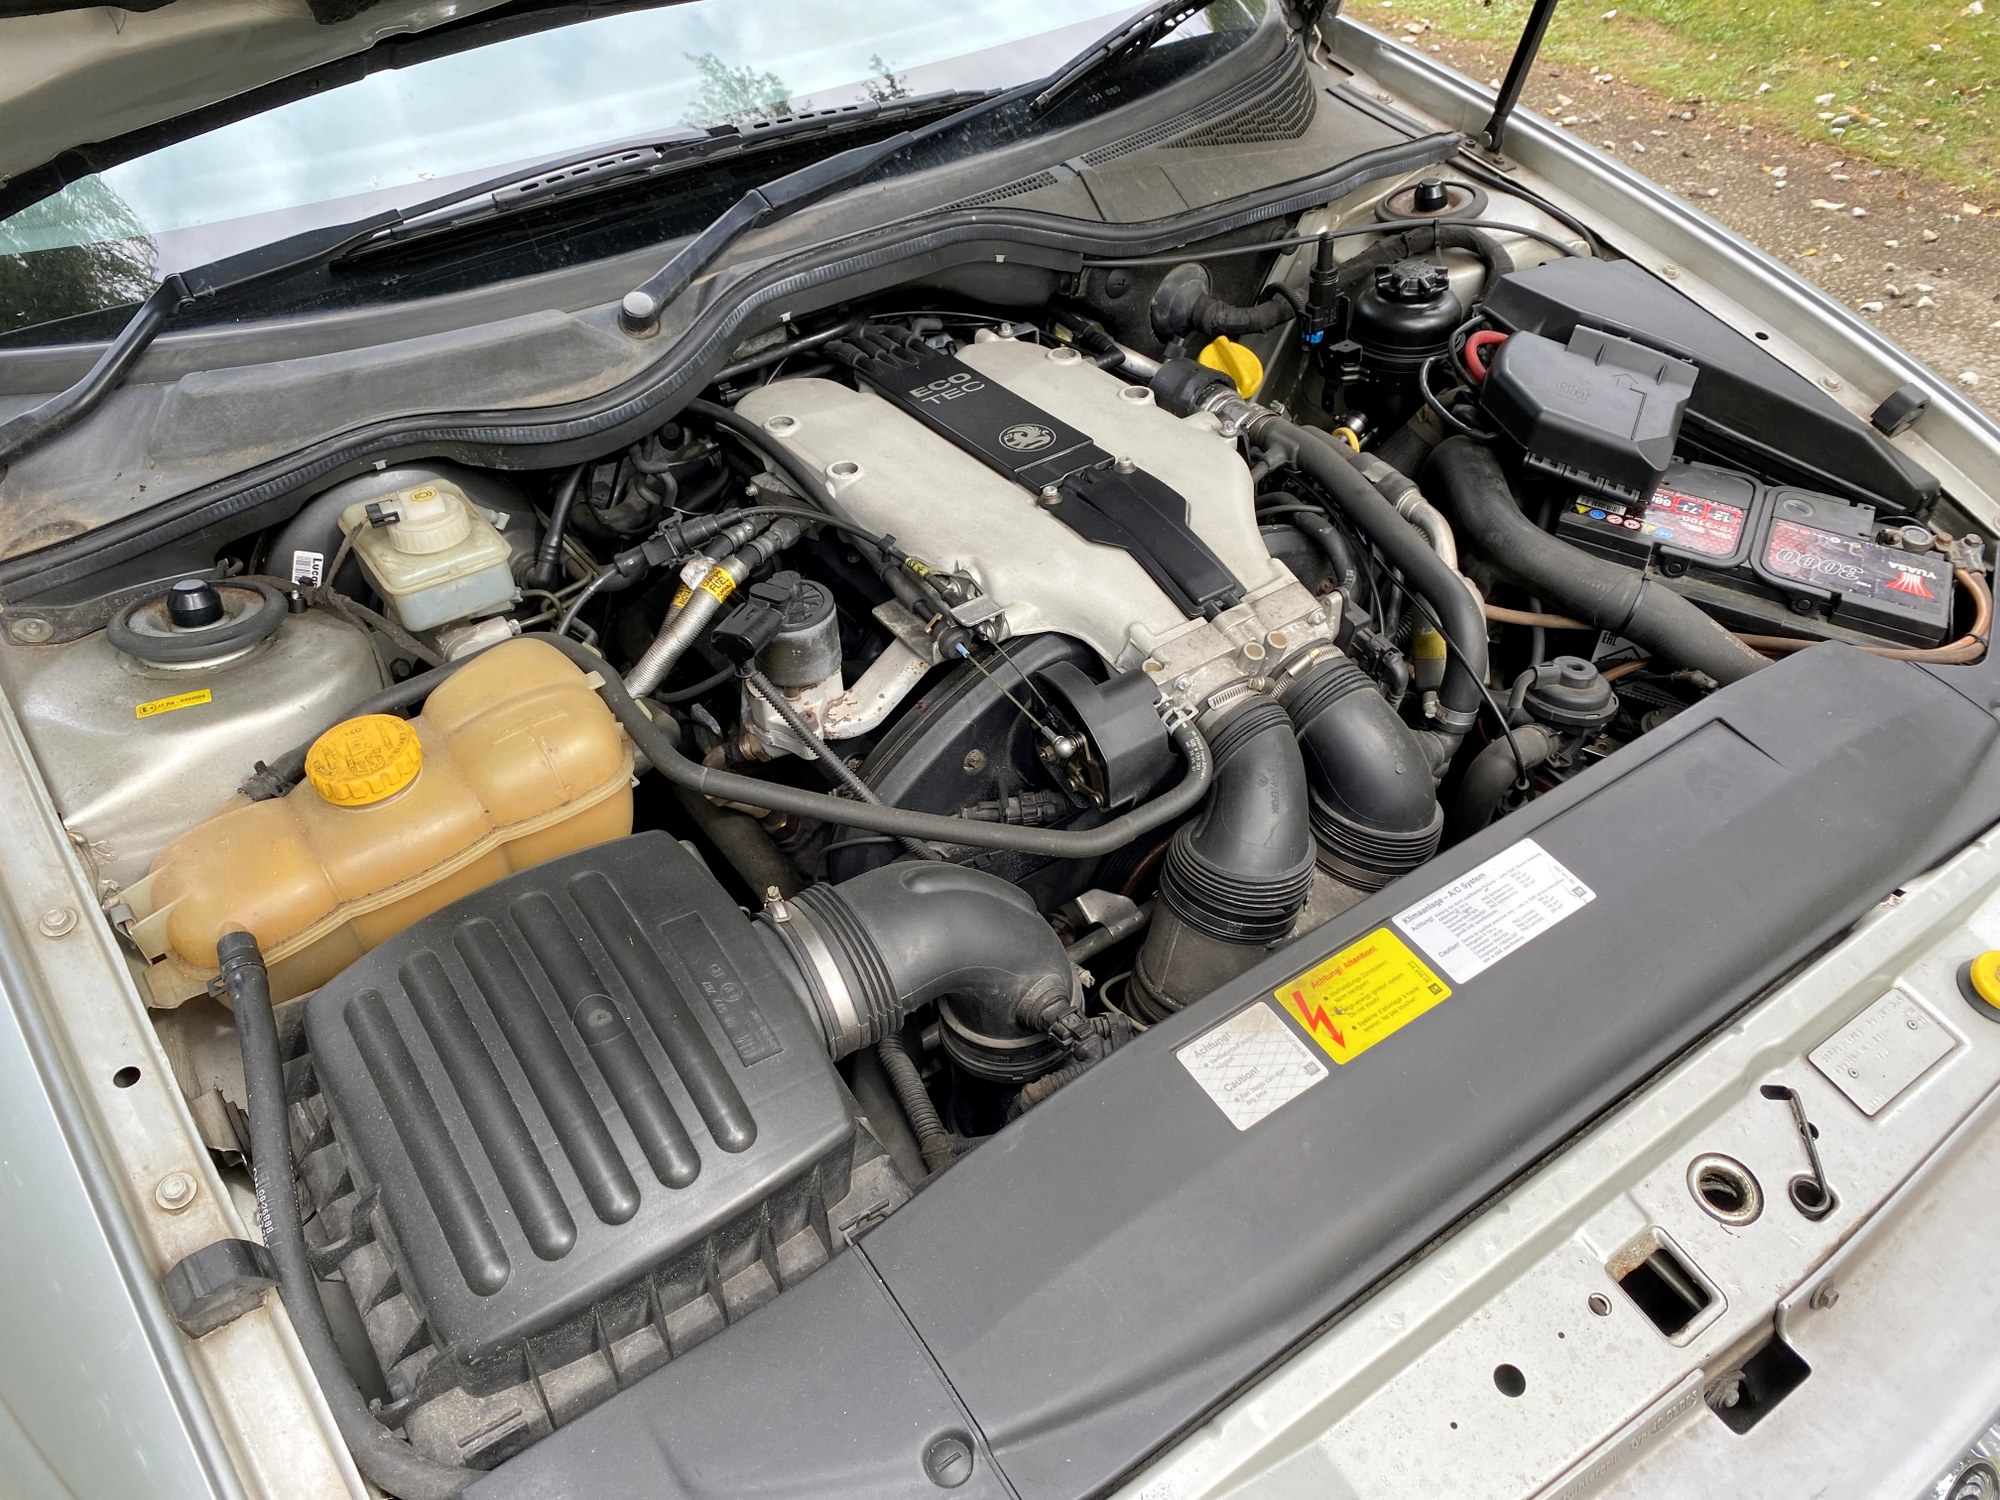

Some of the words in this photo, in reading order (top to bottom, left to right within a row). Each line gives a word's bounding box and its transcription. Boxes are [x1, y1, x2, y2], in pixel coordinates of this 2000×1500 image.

[908, 371, 972, 398] ECO
[921, 383, 984, 403] TEC
[1712, 512, 1730, 523] 12
[1775, 549, 1863, 580] 3000
[1888, 561, 1936, 579] YUASA
[1401, 896, 1444, 924] Klimaanlage
[1447, 885, 1462, 897] A/C
[1460, 871, 1487, 890] System
[1410, 915, 1434, 931] Achtung!
[1437, 942, 1460, 957] Caution!
[1310, 966, 1344, 989] Achtung!
[1342, 945, 1377, 968] Attention!
[1405, 985, 1420, 996] haute
[1356, 1005, 1366, 1013] not
[1380, 1013, 1389, 1021] Ne
[1388, 1007, 1399, 1017] pas
[1192, 1030, 1232, 1059] Achtung!
[1222, 1065, 1260, 1093] Caution!
[1239, 1089, 1251, 1099] Fan
[1264, 1073, 1275, 1083] can
[1274, 1066, 1287, 1077] start
[1245, 1096, 1256, 1106] any
[1255, 1088, 1268, 1099] time
